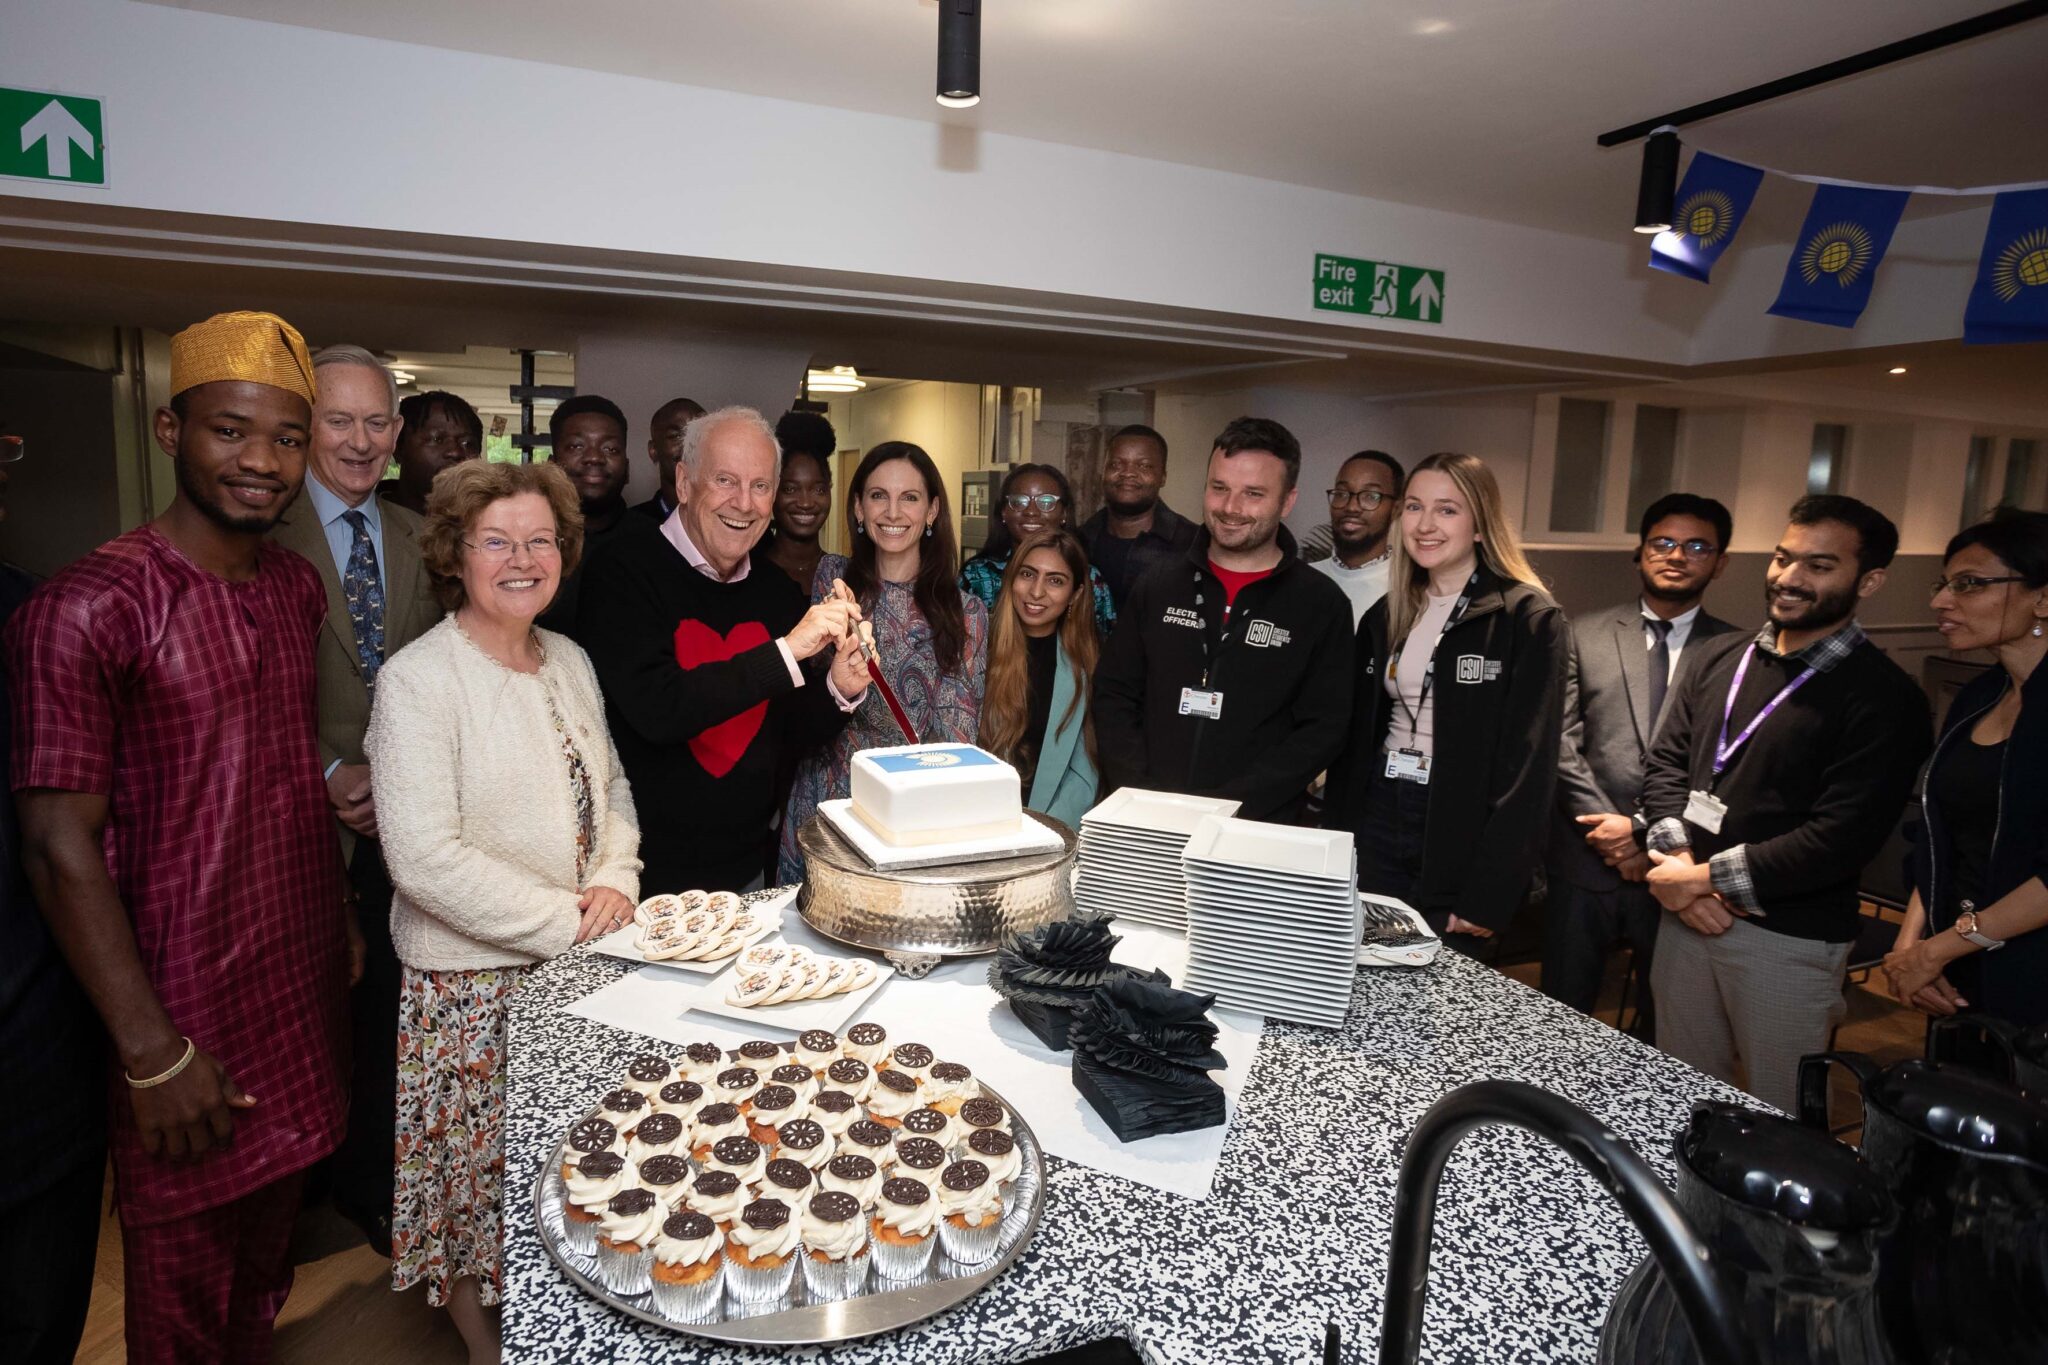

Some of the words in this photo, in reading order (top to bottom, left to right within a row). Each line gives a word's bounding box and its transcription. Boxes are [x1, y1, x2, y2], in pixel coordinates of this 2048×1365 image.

[1319, 258, 1357, 283] Fire
[1319, 286, 1355, 306] exit
[1166, 606, 1198, 619] ELECTE
[1249, 622, 1271, 643] CSU
[1460, 658, 1480, 680] CSU
[1180, 701, 1190, 713] E
[1387, 764, 1397, 776] E
